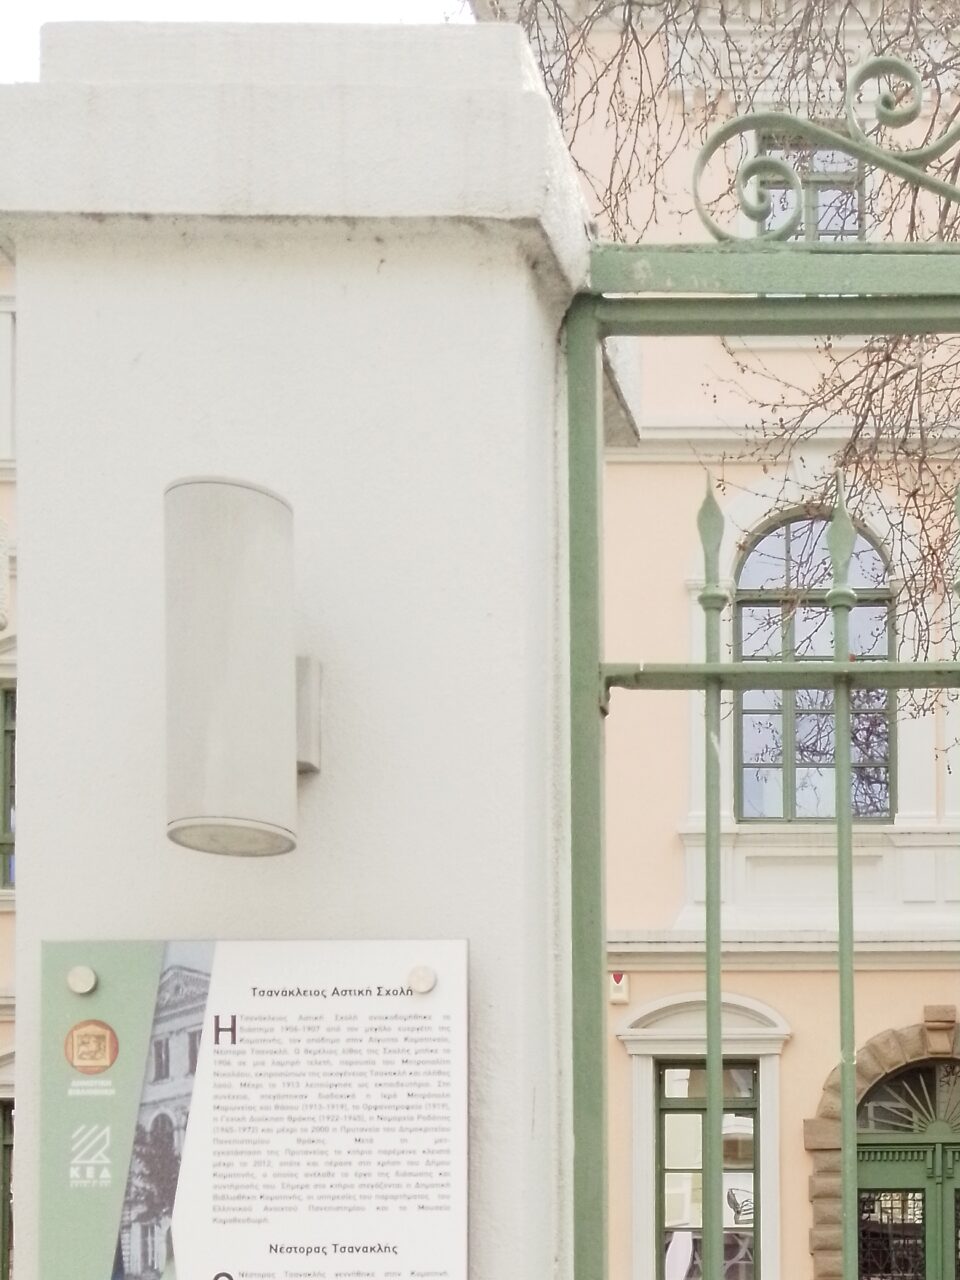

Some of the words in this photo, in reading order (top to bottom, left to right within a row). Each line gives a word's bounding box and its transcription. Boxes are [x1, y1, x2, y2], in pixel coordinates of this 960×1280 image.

[252, 987, 327, 998] Τσανάκλειος
[332, 987, 372, 997] Αστική
[377, 986, 414, 997] Σχολή
[214, 1015, 237, 1044] Η
[269, 1244, 327, 1256] Νέστορας
[332, 1243, 398, 1255] Τσανακλής
